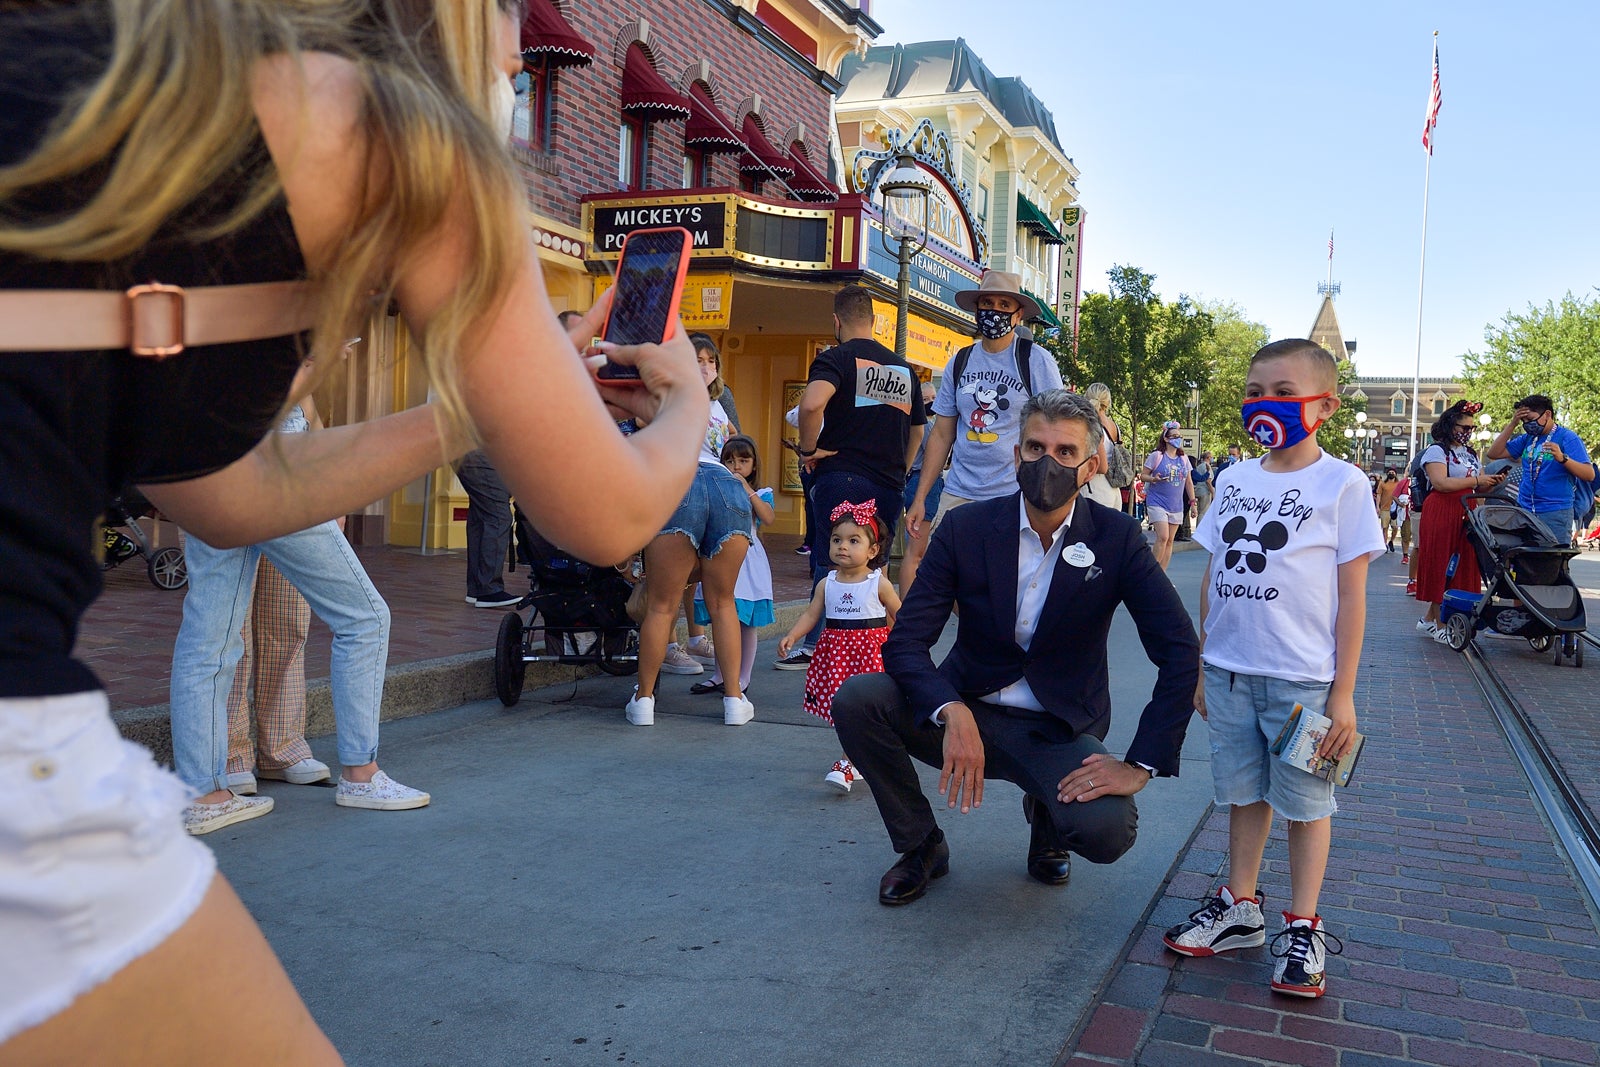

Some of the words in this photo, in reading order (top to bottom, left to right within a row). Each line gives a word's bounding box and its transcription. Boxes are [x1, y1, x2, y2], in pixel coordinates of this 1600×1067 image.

[614, 207, 702, 226] MICKEY'S
[909, 251, 951, 282] STEAMBOAT
[1064, 234, 1076, 279] MAIN
[918, 276, 942, 298] WILLIE
[1061, 291, 1072, 324] STR
[865, 367, 907, 396] Hobie
[958, 369, 1024, 393] Disneyland
[1278, 489, 1313, 532] Boy
[834, 606, 861, 615] Disneyland
